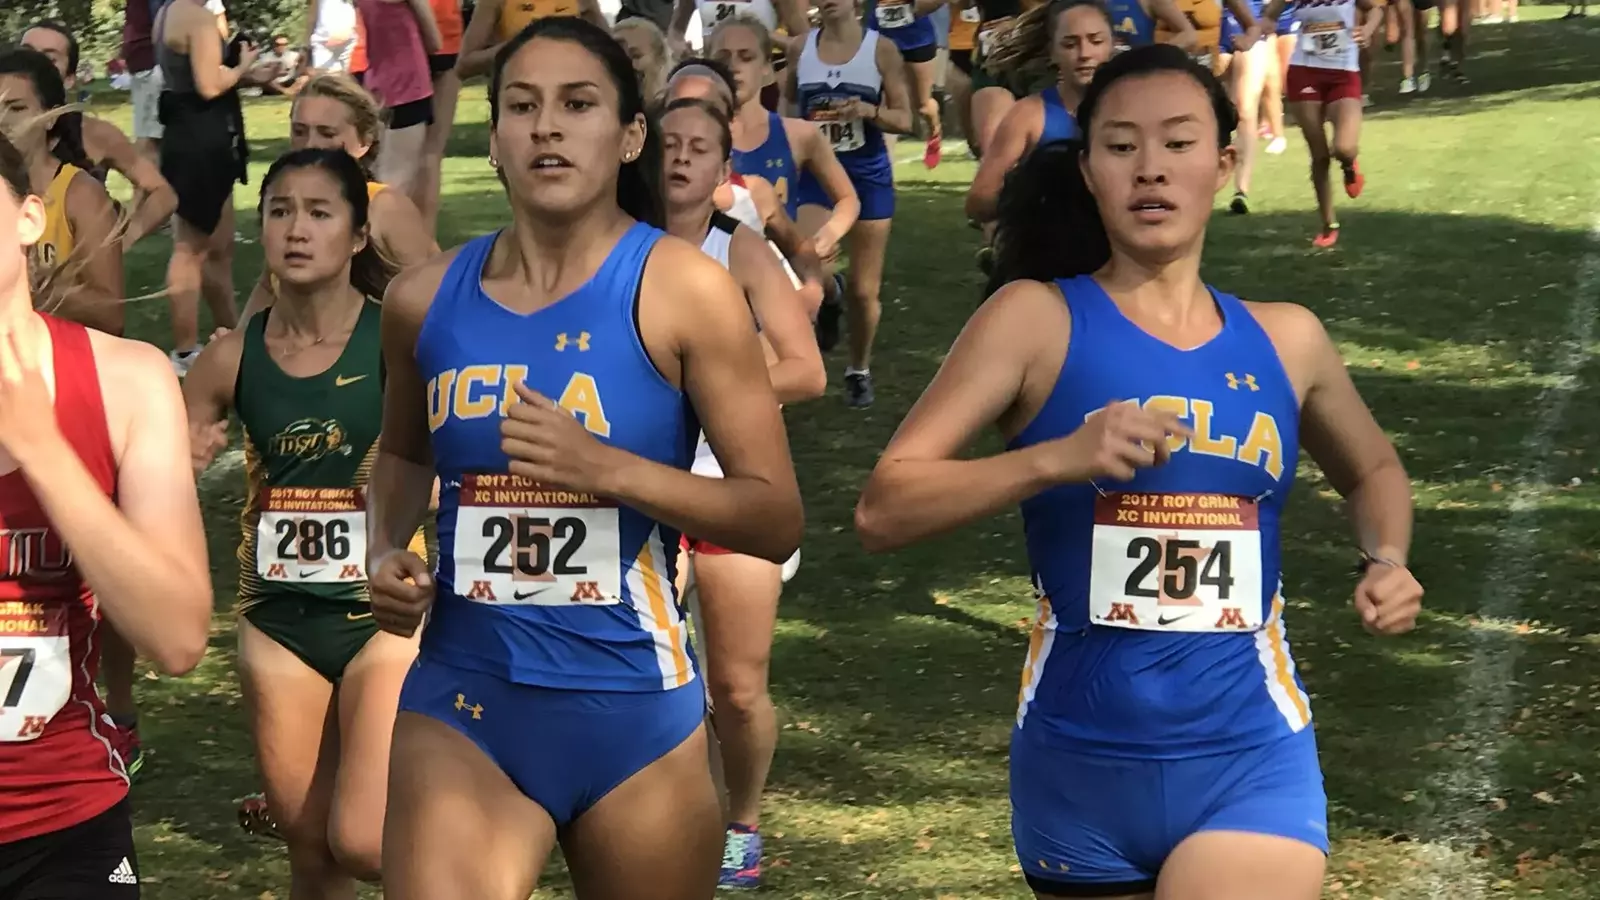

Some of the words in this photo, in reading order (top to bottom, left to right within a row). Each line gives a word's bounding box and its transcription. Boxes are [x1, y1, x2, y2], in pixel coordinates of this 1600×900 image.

[1085, 395, 1285, 482] CLA
[476, 474, 509, 487] 2017
[511, 474, 541, 488] RO
[283, 500, 357, 511] INVITATIONAL
[474, 491, 492, 503] XC
[494, 490, 599, 504] INVITATIONAL
[1121, 493, 1159, 508] 2017
[1162, 495, 1196, 509] ROY
[1198, 496, 1240, 510] GRIAK
[1116, 509, 1140, 523] XC
[1143, 510, 1244, 527] INVITATIONAL
[275, 519, 350, 562] 286
[482, 516, 588, 576] 252
[1125, 536, 1235, 600] 254
[1, 648, 36, 708] 7
